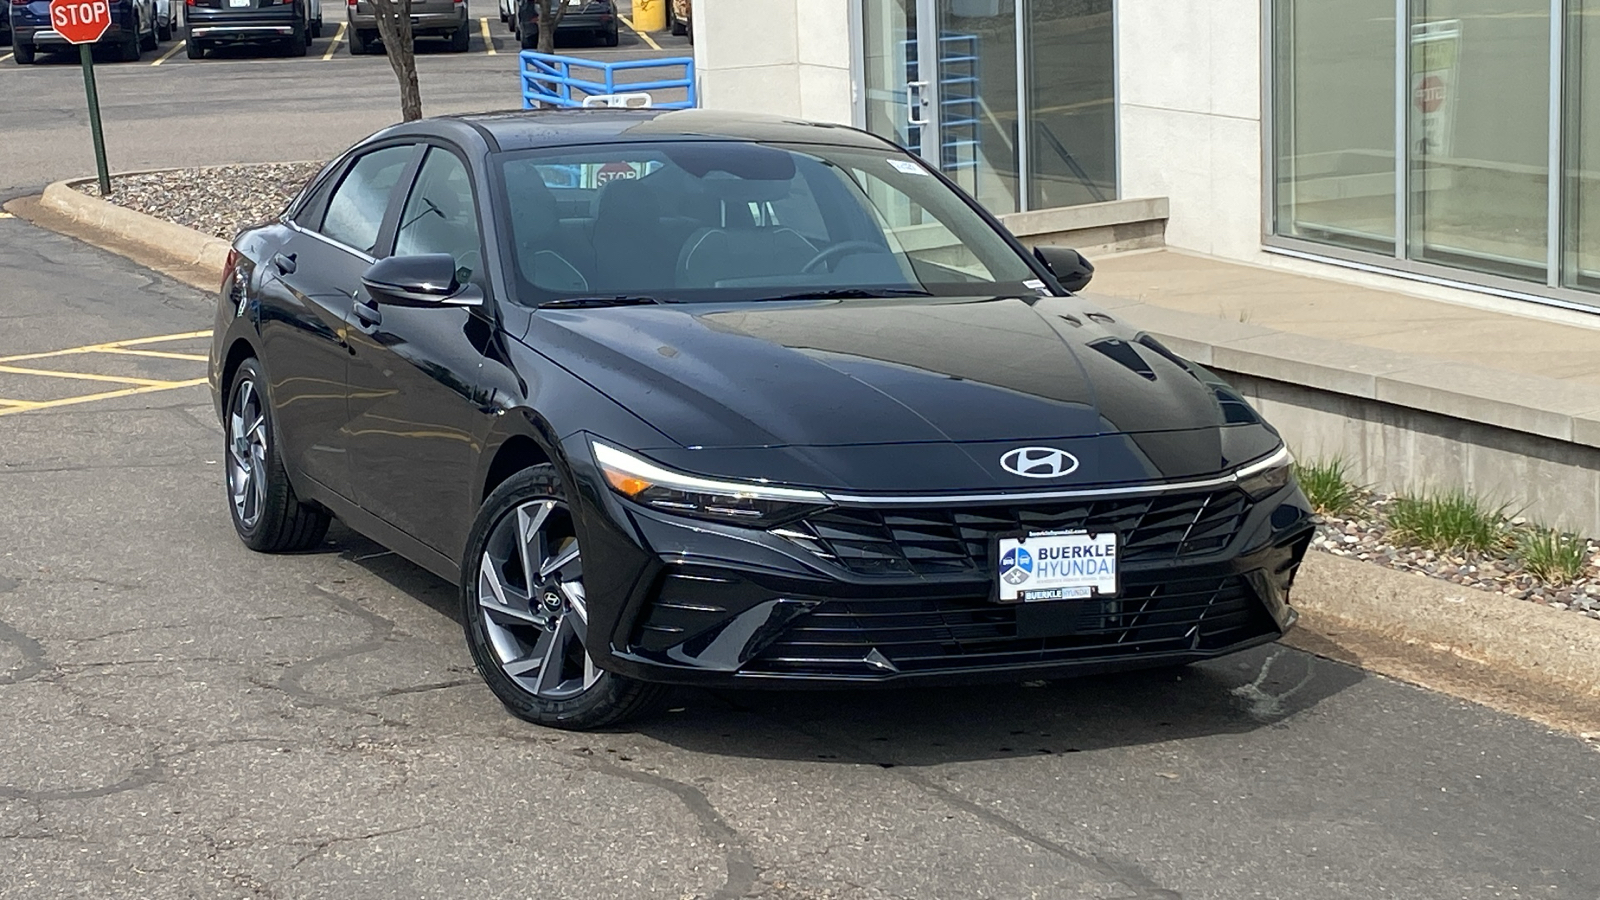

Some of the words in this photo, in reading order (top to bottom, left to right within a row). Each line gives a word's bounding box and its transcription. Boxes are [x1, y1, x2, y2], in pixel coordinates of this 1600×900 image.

[55, 2, 106, 26] STOP
[1038, 544, 1115, 560] BUERKLE
[1037, 559, 1115, 578] HYUNDAI
[1026, 590, 1062, 600] BUERKLE
[1062, 588, 1090, 598] HYUNDAI
